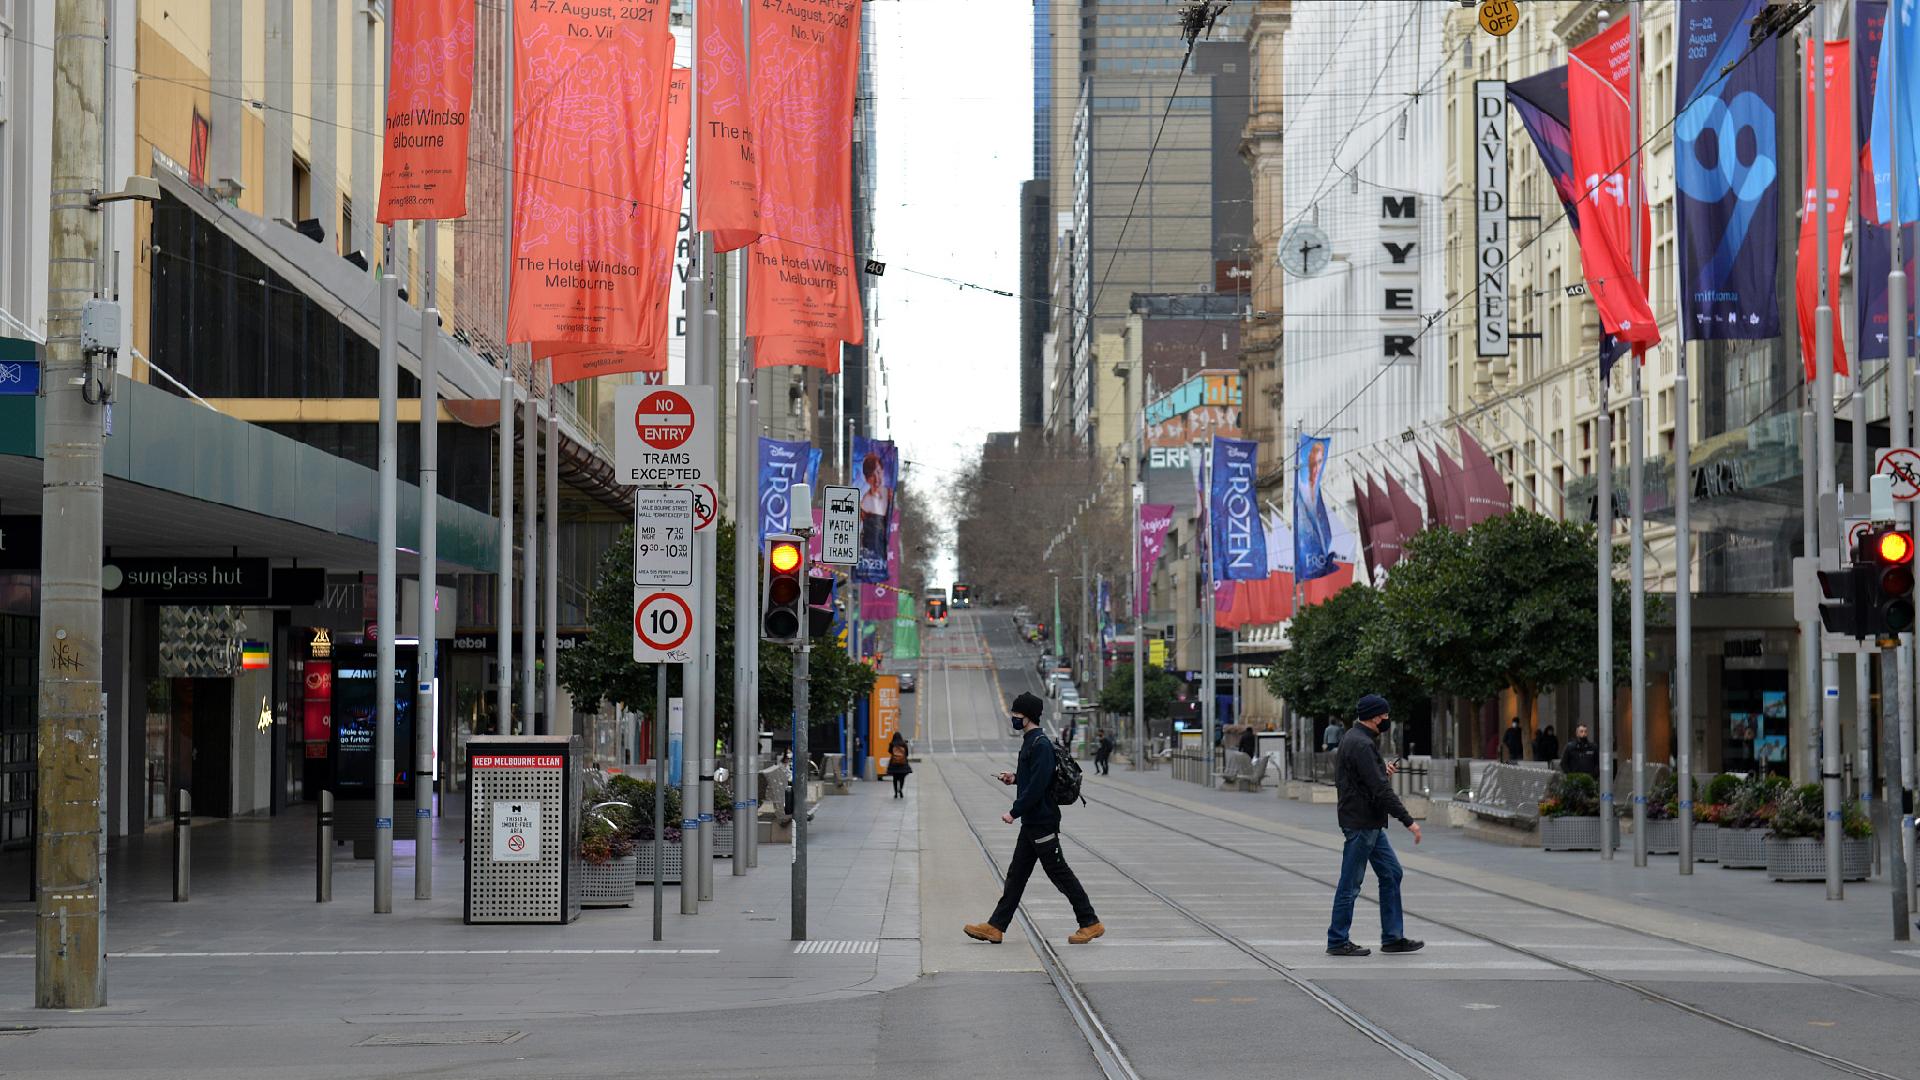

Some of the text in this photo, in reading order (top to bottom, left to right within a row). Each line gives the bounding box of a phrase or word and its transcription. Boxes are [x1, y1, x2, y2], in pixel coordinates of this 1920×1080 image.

[561, 3, 616, 20] August,
[620, 7, 653, 23] 2021
[785, 3, 825, 24] August,
[828, 12, 849, 29] 2021
[1483, 0, 1510, 18] CUT
[1489, 15, 1513, 31] OFF
[568, 24, 592, 38] No.
[792, 25, 809, 40] No.
[1689, 32, 1717, 46] August
[1688, 46, 1707, 59] 2021
[670, 80, 686, 90] air
[416, 109, 464, 127] Windso
[709, 122, 739, 139] The
[393, 132, 443, 149] elbourne
[1482, 98, 1504, 343] DAVID JONES
[518, 258, 640, 277] The Hotel Windsor
[756, 252, 848, 276] The Hotel Windso
[867, 262, 884, 275] 40
[676, 213, 690, 336] DAVID
[780, 270, 838, 290] Melbourne
[1382, 196, 1416, 357] MYER
[545, 274, 615, 291] Melbourne
[1567, 286, 1584, 295] 40
[656, 399, 674, 412] NO
[644, 428, 686, 441] ENTRY
[643, 453, 690, 465] TRAMS
[631, 469, 701, 481] EXCEPTED
[761, 461, 798, 532] FROZ
[1223, 462, 1253, 568] FROZEN
[829, 519, 854, 531] WATCH
[641, 526, 656, 534] MID
[666, 527, 674, 540] 7
[834, 533, 849, 545] FOR
[640, 544, 649, 556] 9
[666, 545, 678, 558] 10
[829, 547, 854, 559] TRAMS
[1305, 553, 1327, 569] FRO
[128, 565, 244, 589] sunglass hut
[650, 609, 678, 634] 10
[453, 637, 576, 649] rebel rbel
[352, 669, 407, 679] AMFY
[1248, 667, 1270, 677] MY
[340, 736, 349, 744] go
[474, 757, 560, 766] KEEP MELBOURNE CLEAN
